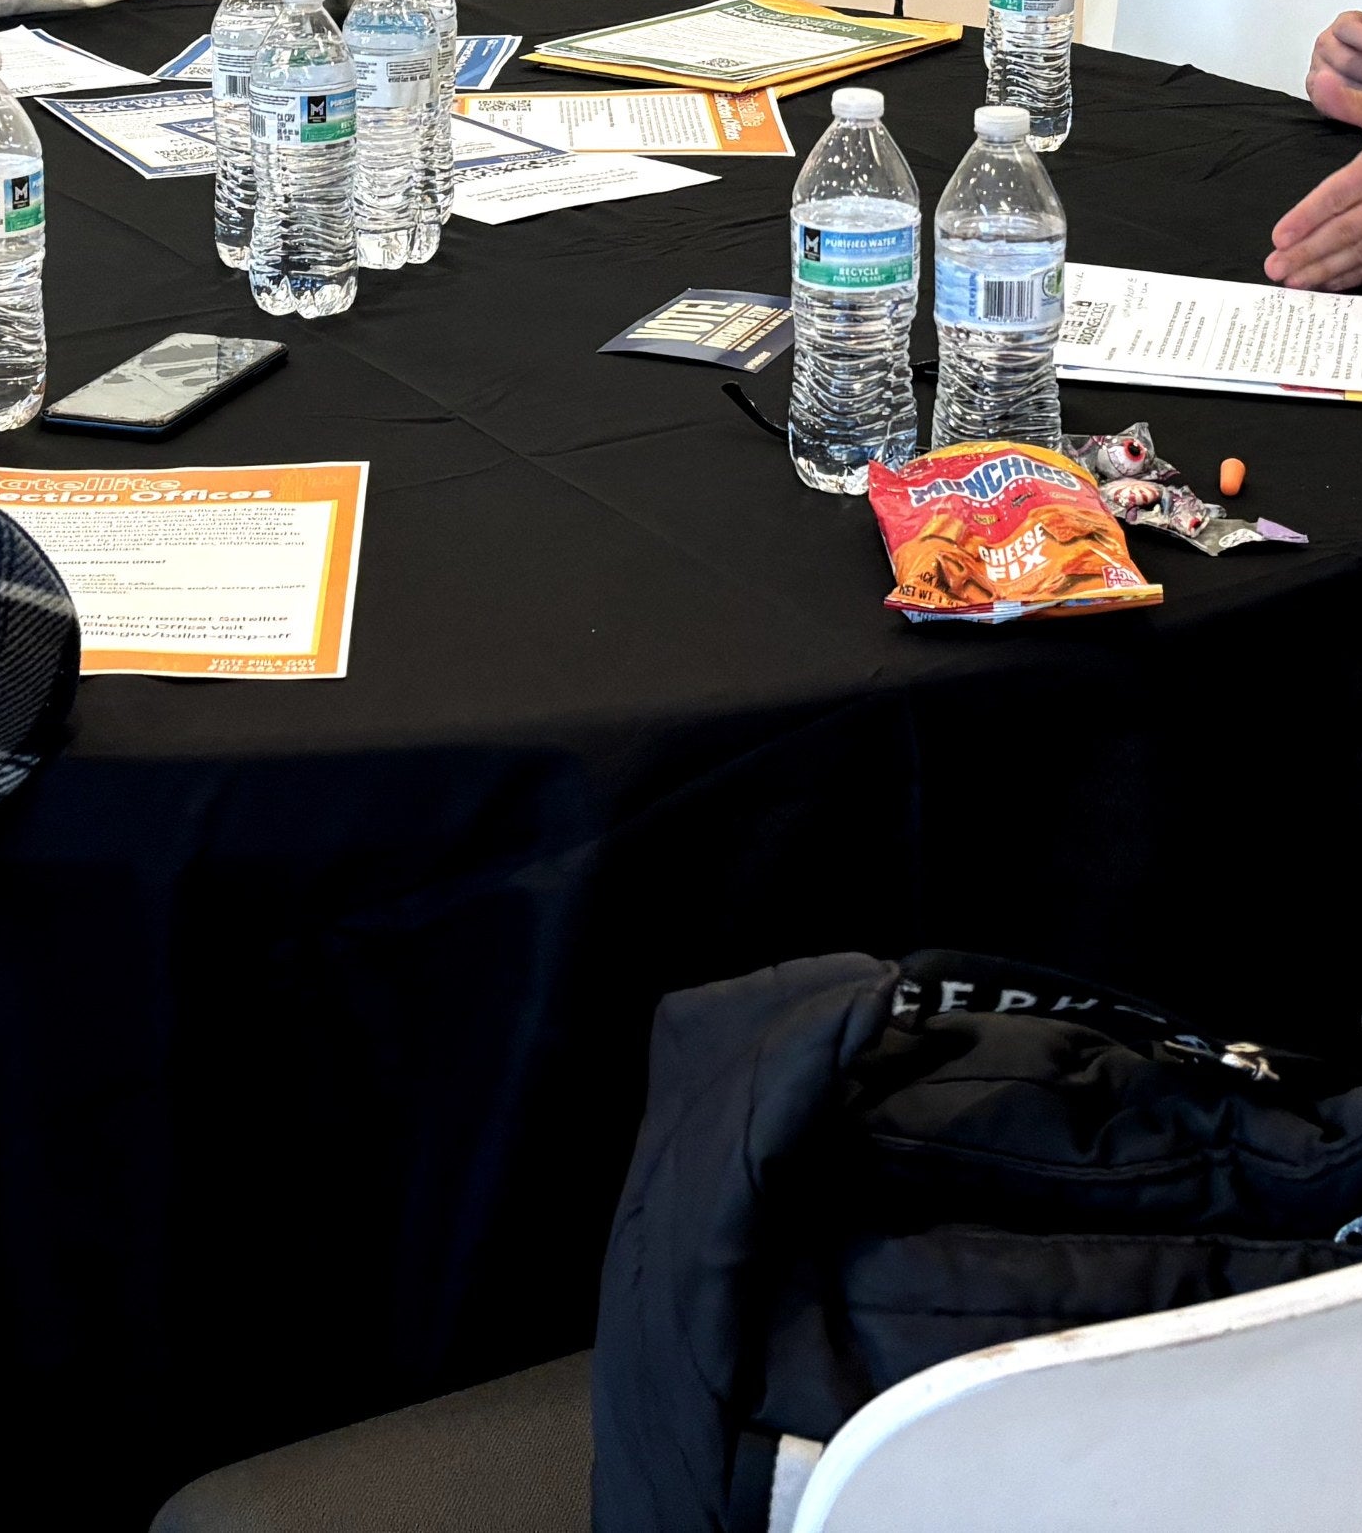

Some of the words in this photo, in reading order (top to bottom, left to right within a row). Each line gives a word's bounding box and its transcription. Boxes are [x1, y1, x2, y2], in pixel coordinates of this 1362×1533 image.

[824, 237, 868, 250] PURIFIED
[869, 236, 897, 248] WATER
[838, 267, 879, 277] RECYCLE
[910, 454, 1080, 507] MUNCHIES
[129, 489, 273, 503] Offices
[978, 522, 1047, 566] CHEESE
[985, 544, 1049, 583] FIX
[899, 585, 916, 598] NET
